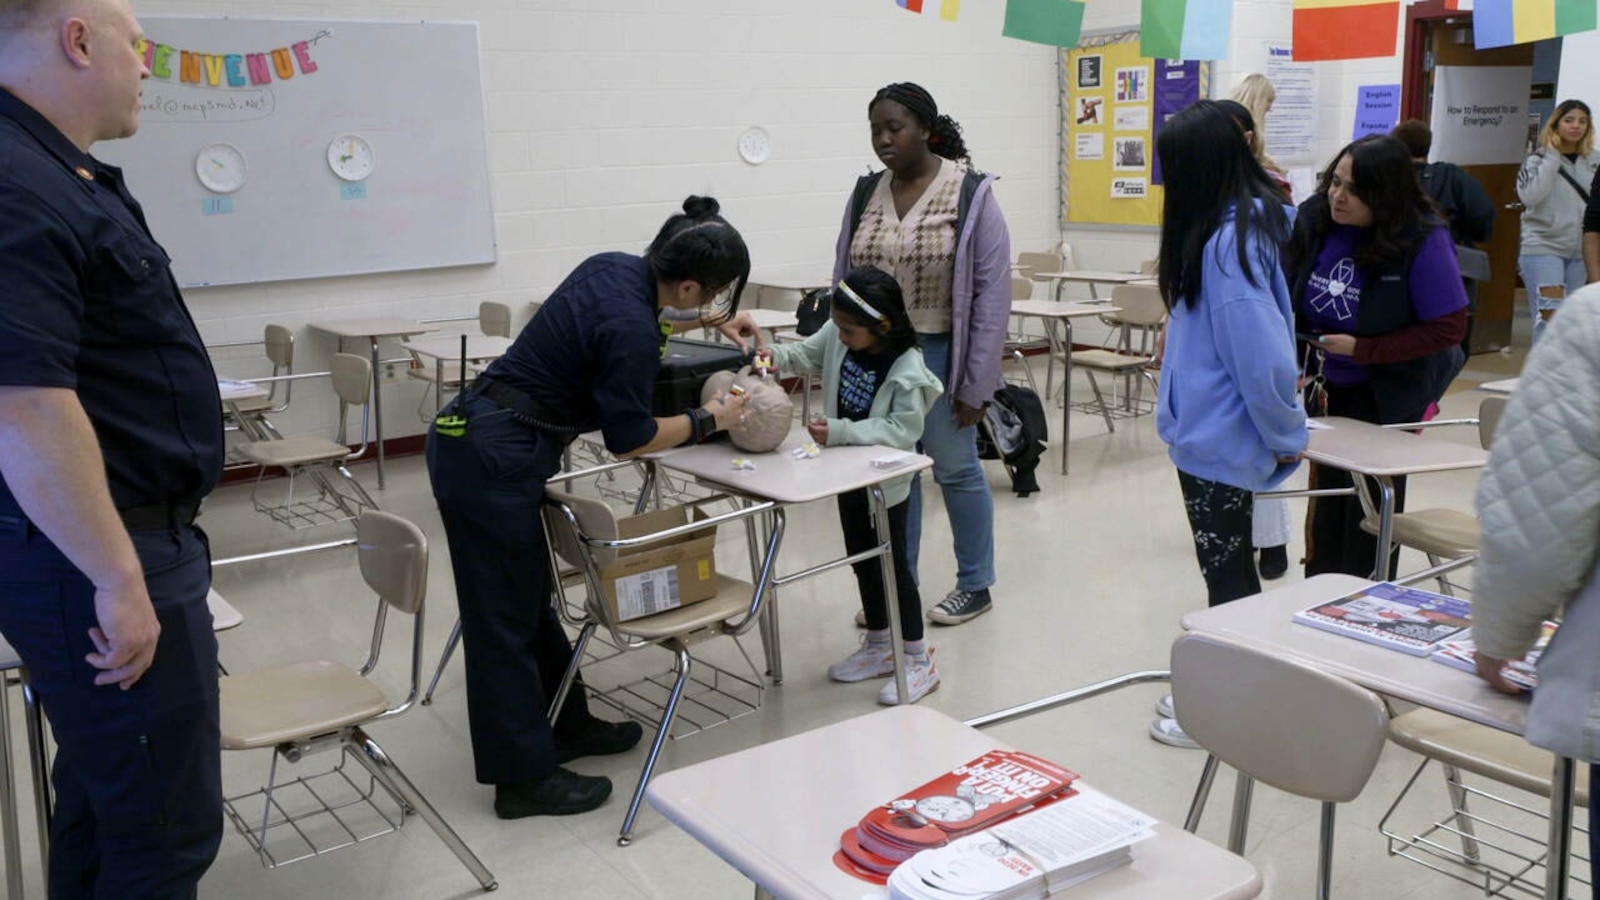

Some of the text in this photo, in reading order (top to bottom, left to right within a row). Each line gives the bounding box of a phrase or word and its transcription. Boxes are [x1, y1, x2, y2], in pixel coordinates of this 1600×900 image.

[1365, 91, 1392, 99] English
[1447, 105, 1462, 115] How
[1463, 105, 1472, 115] to
[1473, 105, 1501, 116] Respond
[1463, 115, 1503, 127] Emergency?
[968, 765, 1042, 799] FINGER
[1011, 771, 1051, 789] ON
[976, 780, 1019, 803] PUT
